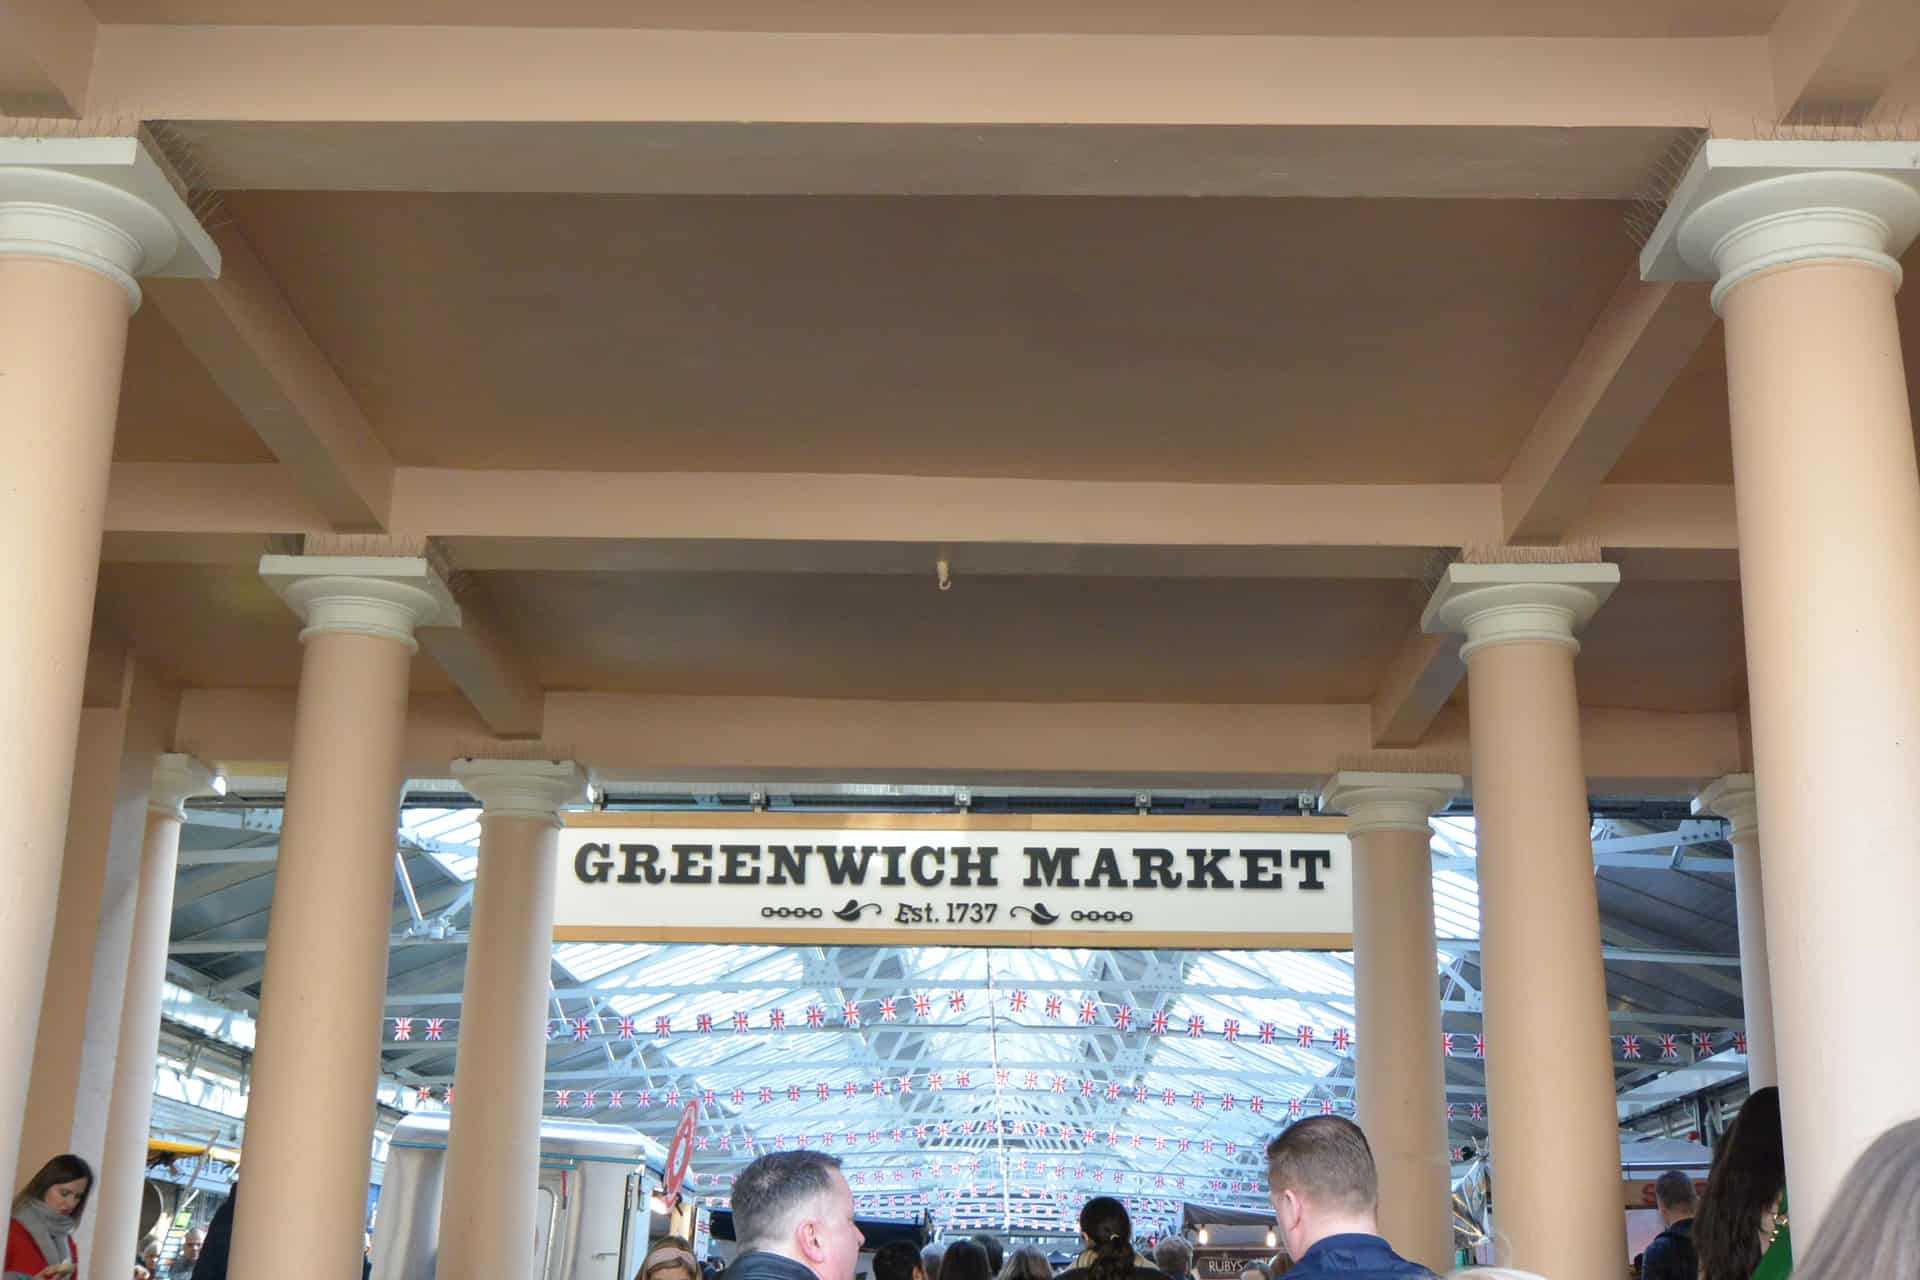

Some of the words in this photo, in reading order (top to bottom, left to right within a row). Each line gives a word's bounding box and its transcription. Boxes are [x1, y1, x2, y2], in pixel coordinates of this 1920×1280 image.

[574, 842, 998, 888] GREENWICH
[1023, 847, 1332, 890] MARKET
[894, 902, 939, 925] Est.
[946, 902, 998, 924] 1737
